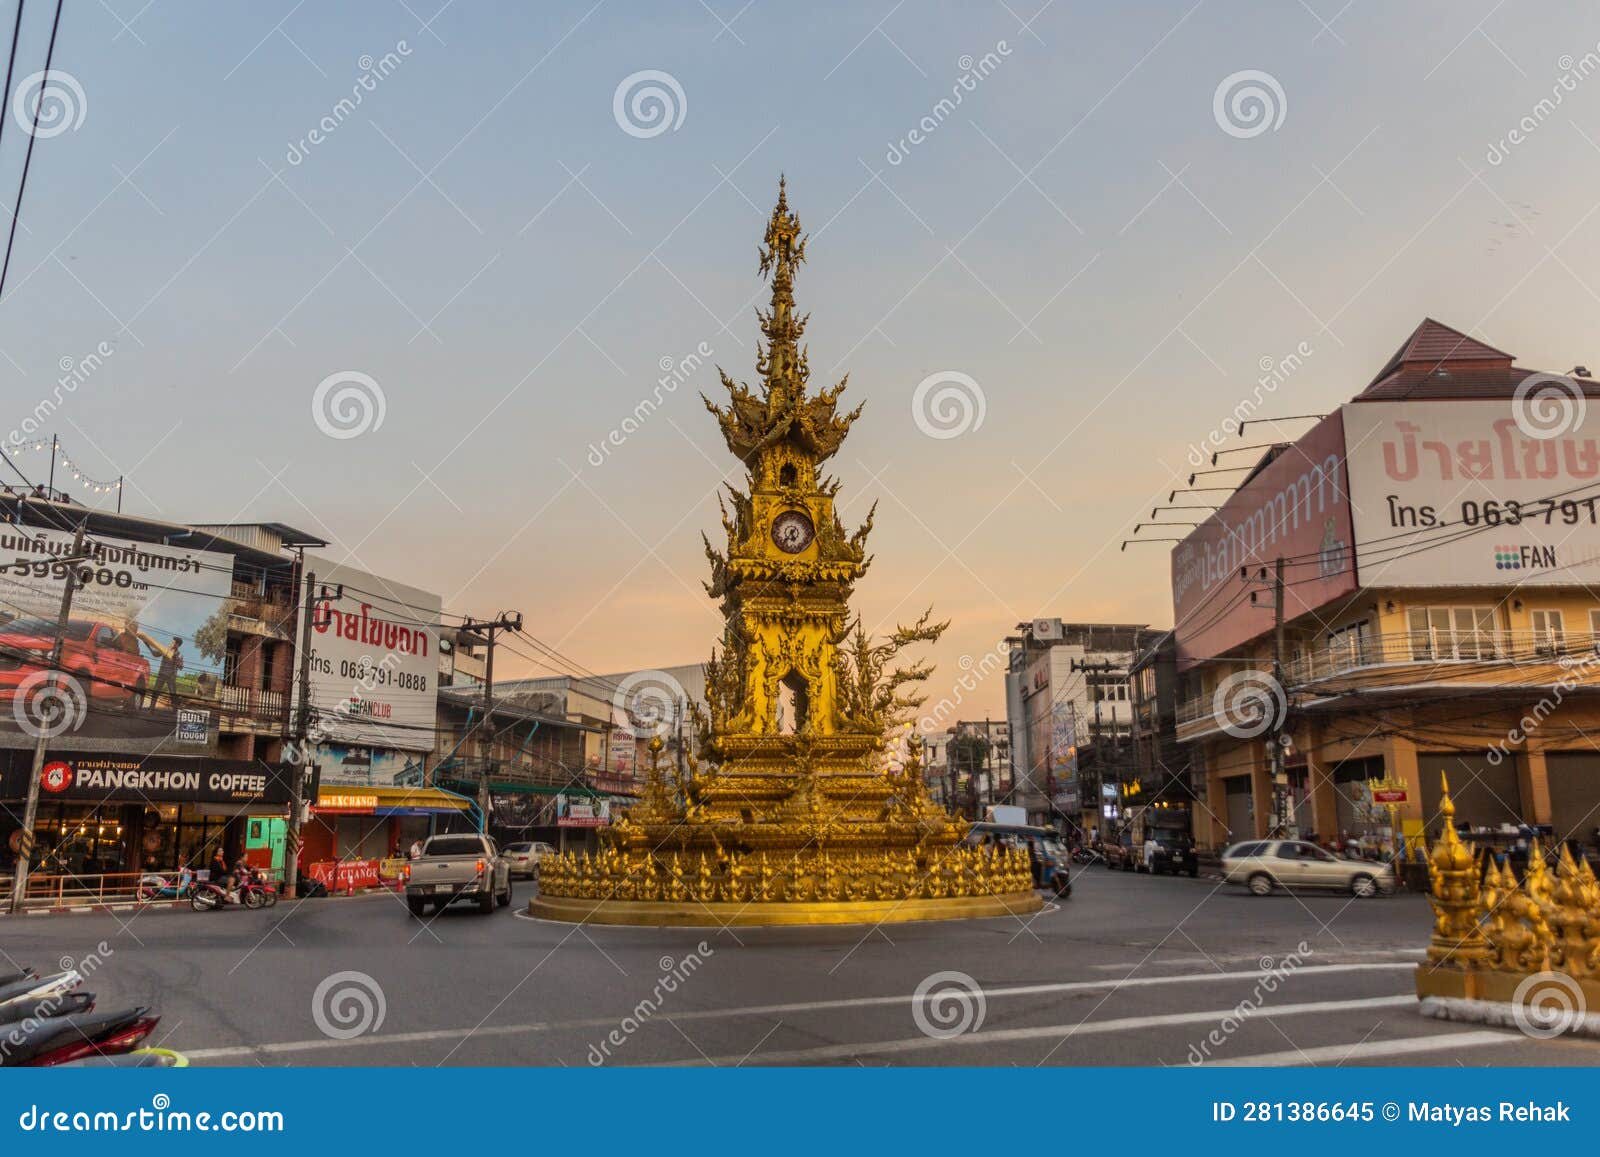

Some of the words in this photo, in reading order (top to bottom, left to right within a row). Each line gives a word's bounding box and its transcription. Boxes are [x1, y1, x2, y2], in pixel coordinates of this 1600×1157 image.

[1386, 494, 1446, 527] โทร.
[340, 659, 426, 692] 063-791-0888
[181, 712, 206, 723] BUILT
[180, 731, 205, 740] TOUGH
[76, 769, 200, 790] PANGKHON
[209, 773, 266, 791] COFFEE
